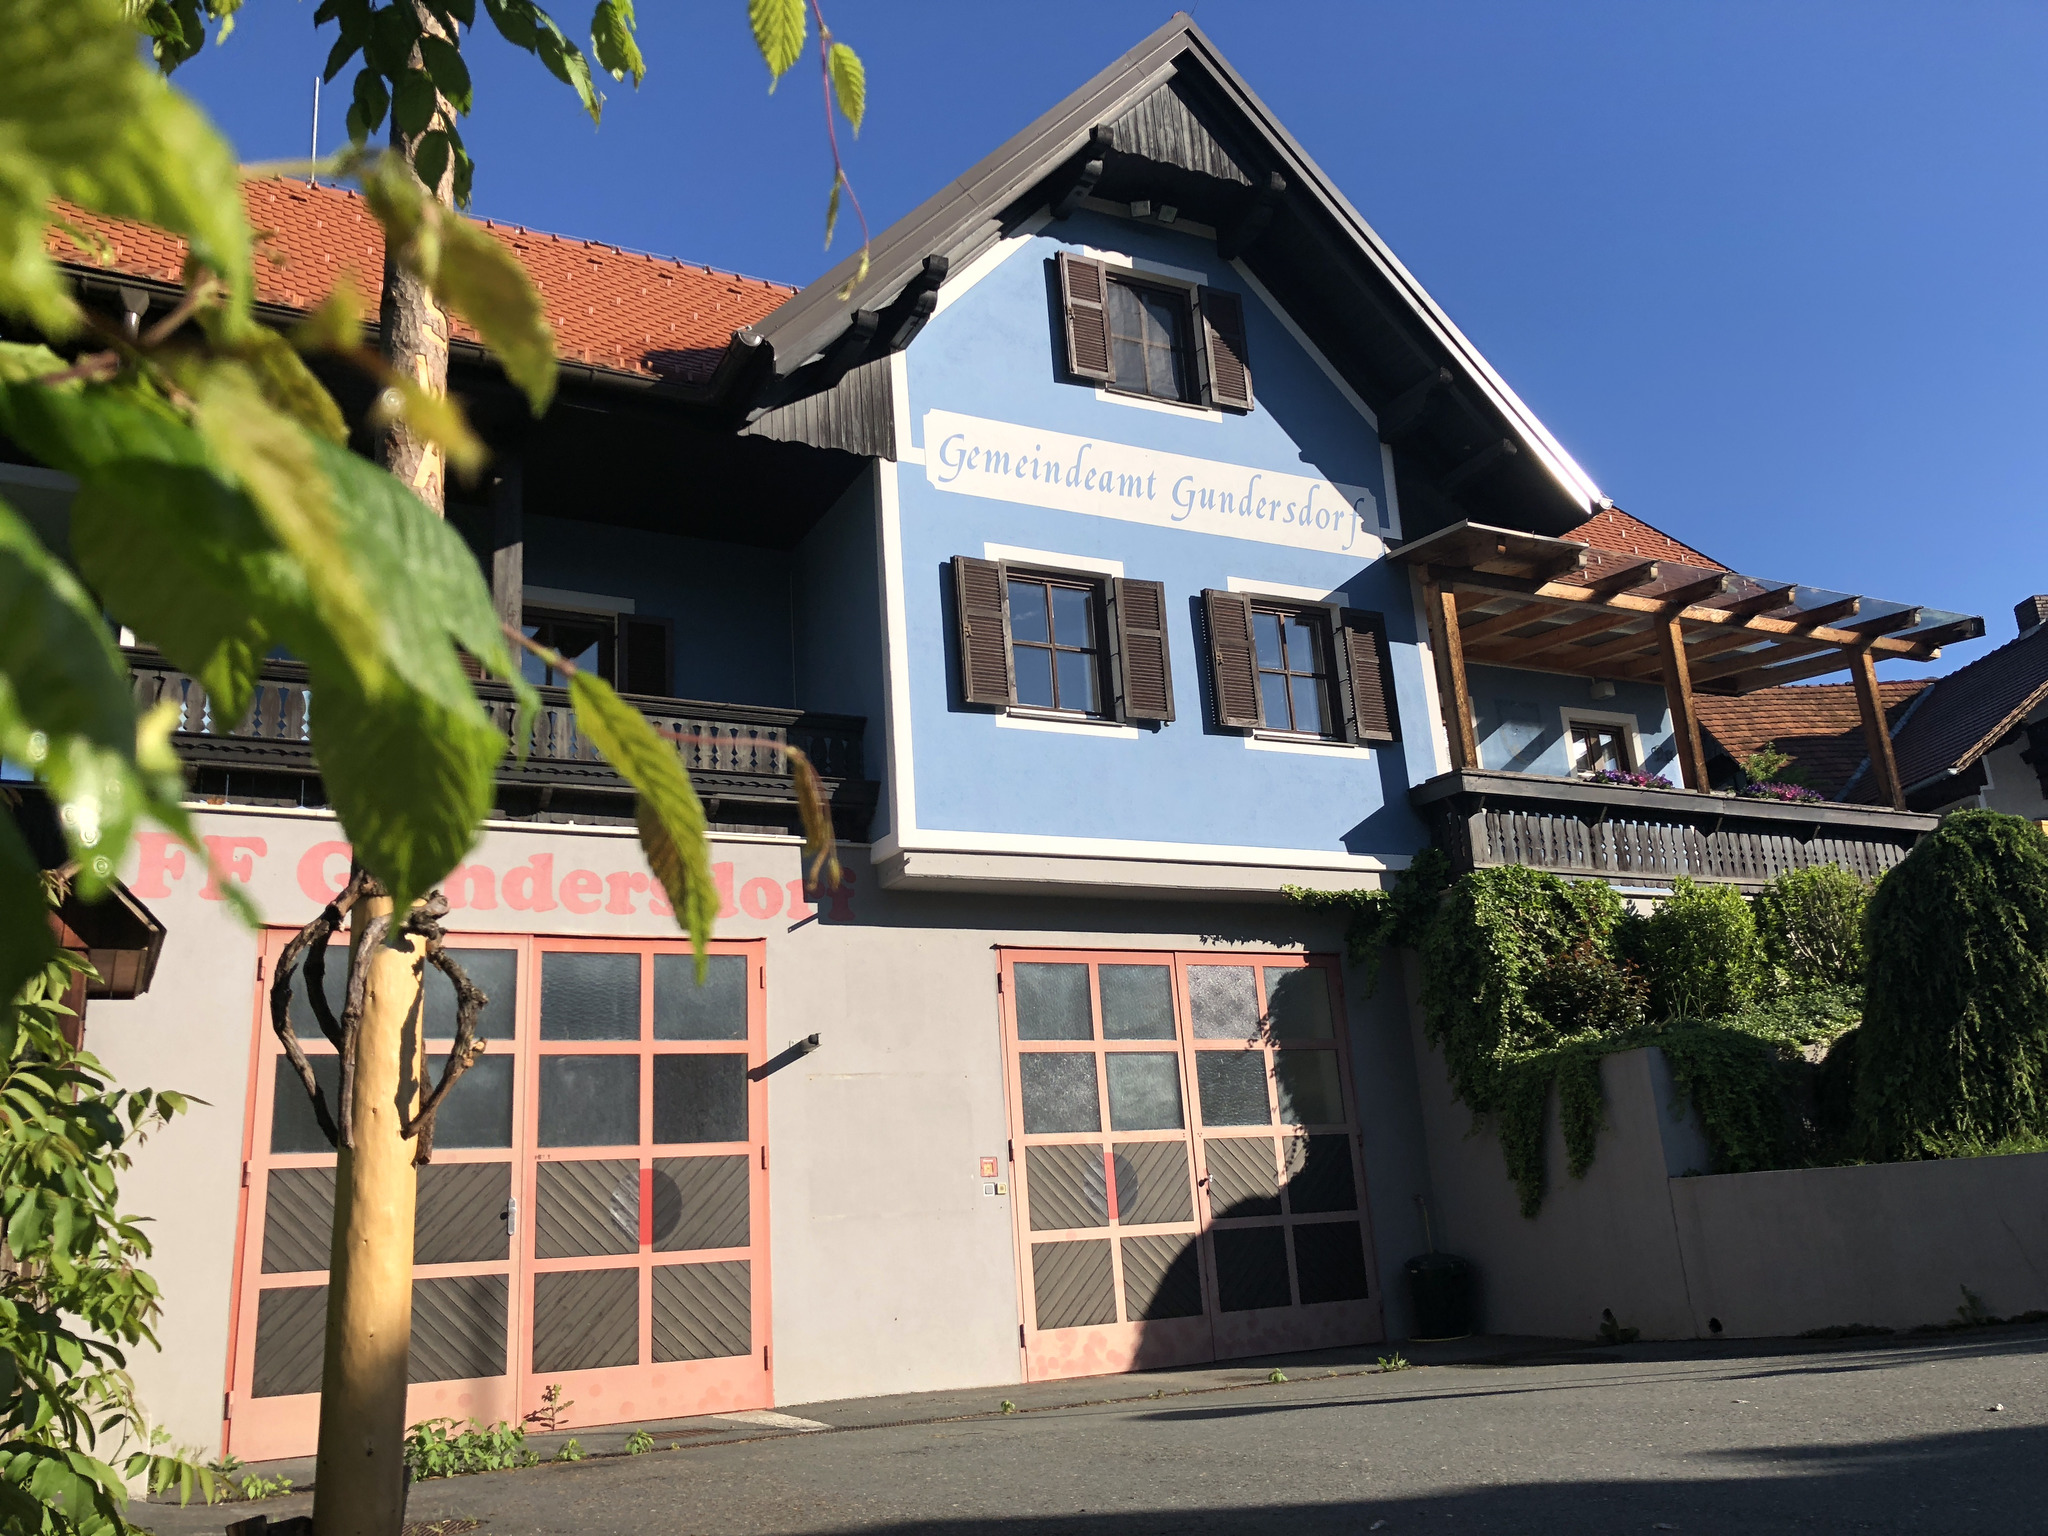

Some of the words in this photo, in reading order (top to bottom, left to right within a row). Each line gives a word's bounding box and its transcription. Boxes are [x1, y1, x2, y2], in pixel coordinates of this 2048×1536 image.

[938, 433, 1157, 500] Gemeindeamt
[1170, 473, 1365, 551] Gundersdorf
[130, 831, 268, 901] FF
[296, 840, 857, 922] Gnderorf
